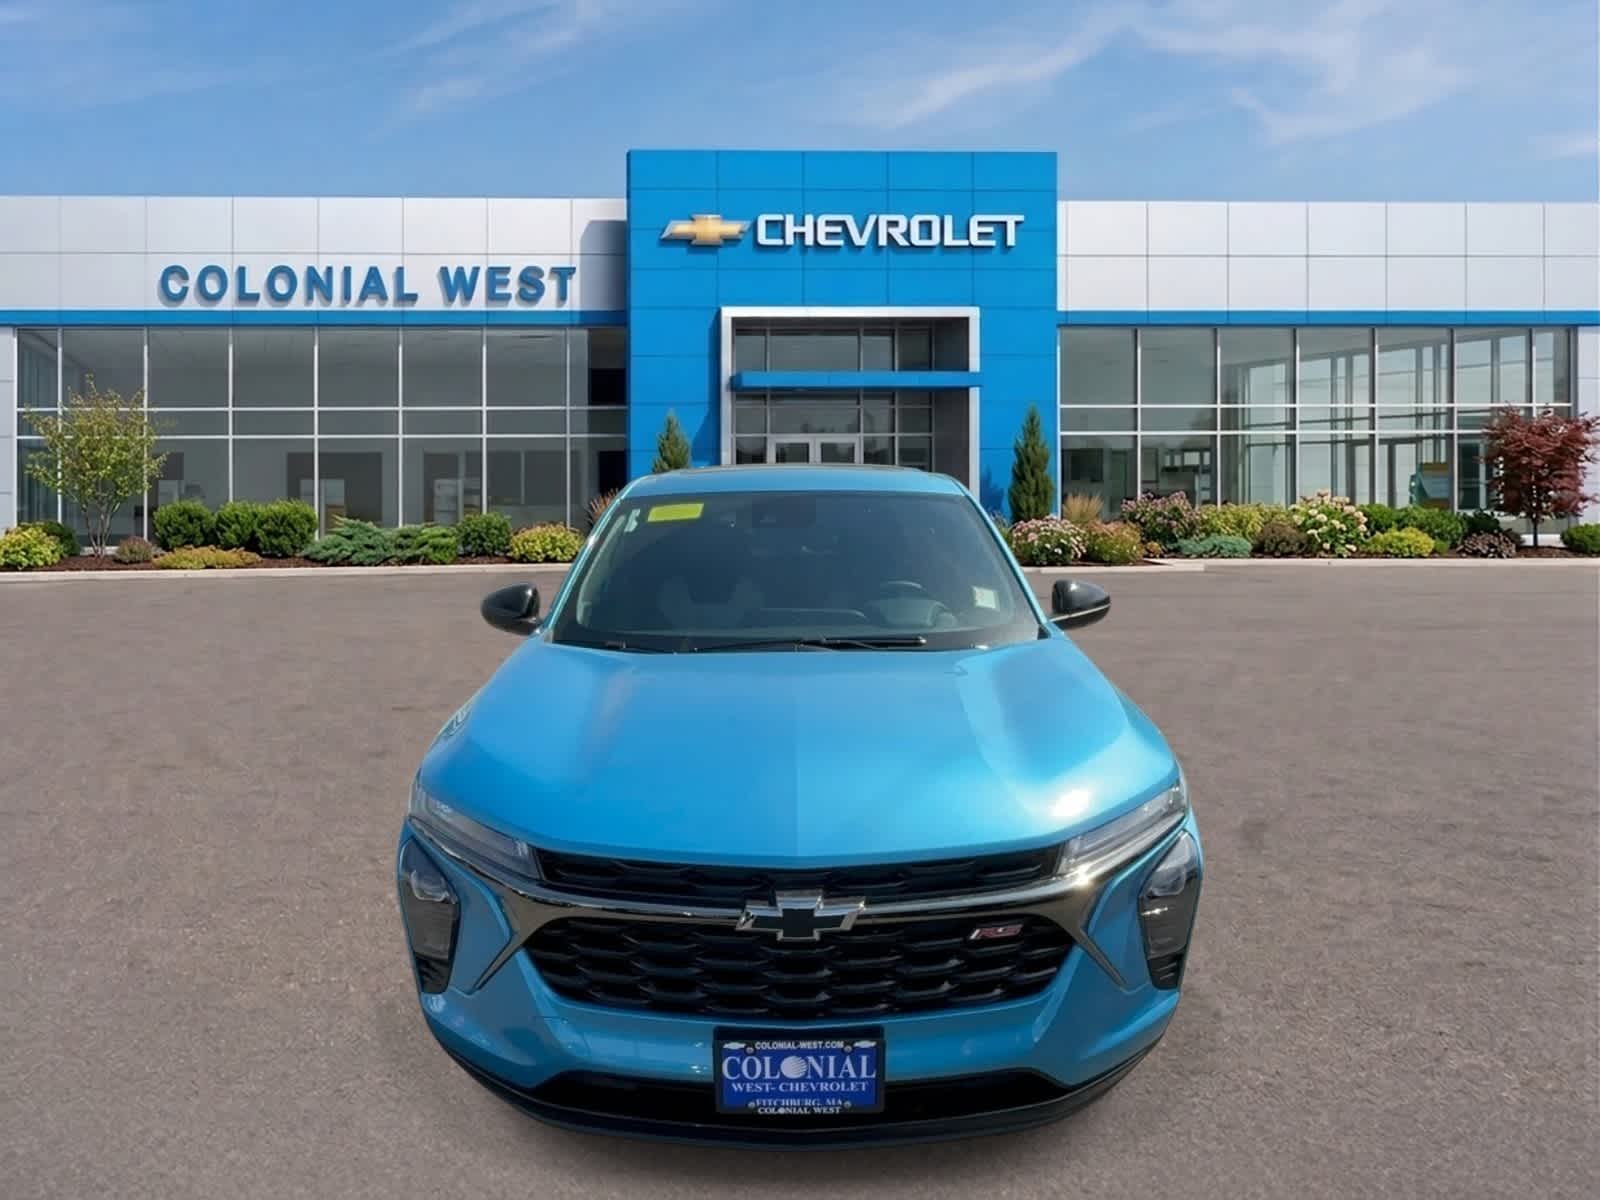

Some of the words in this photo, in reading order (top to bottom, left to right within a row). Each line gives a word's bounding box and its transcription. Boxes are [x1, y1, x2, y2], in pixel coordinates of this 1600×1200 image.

[756, 213, 1025, 247] CHEVROLET
[159, 264, 419, 307] COLONIAL
[437, 265, 577, 305] WEST
[969, 923, 1024, 940] RS
[755, 1041, 844, 1050] COLONIAL-WEST.COM
[722, 1055, 877, 1080] COLONIAL
[731, 1082, 776, 1093] WEST-
[778, 1081, 869, 1093] CHEVROLET
[757, 1106, 811, 1115] COLONIAL
[813, 1106, 842, 1115] WEST
